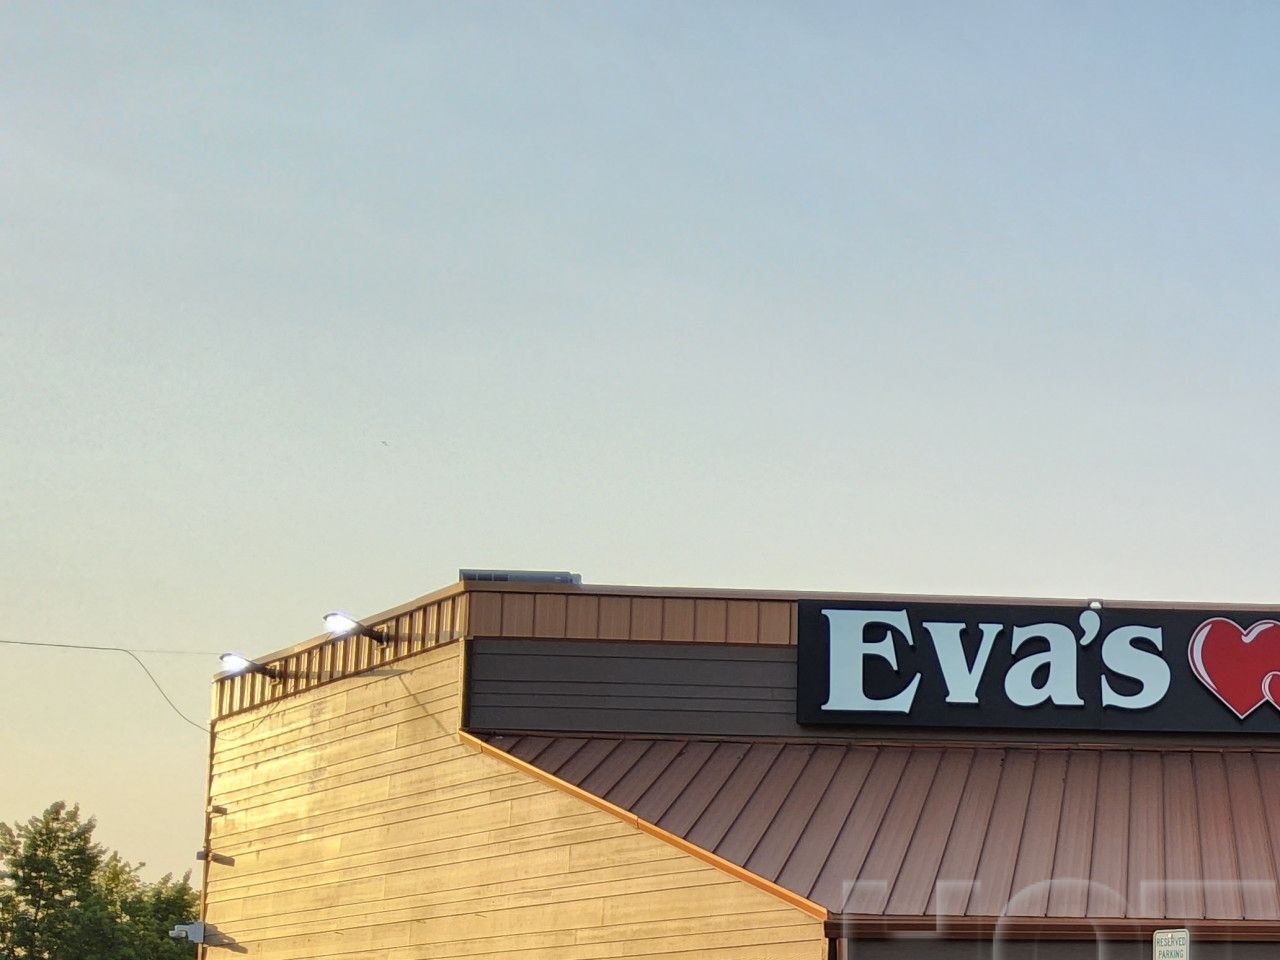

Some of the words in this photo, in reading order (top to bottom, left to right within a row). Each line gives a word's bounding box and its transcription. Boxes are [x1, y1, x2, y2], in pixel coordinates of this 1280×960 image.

[821, 608, 1172, 714] Eva's
[1156, 937, 1186, 947] RESERVED
[1158, 949, 1184, 959] PARKING
